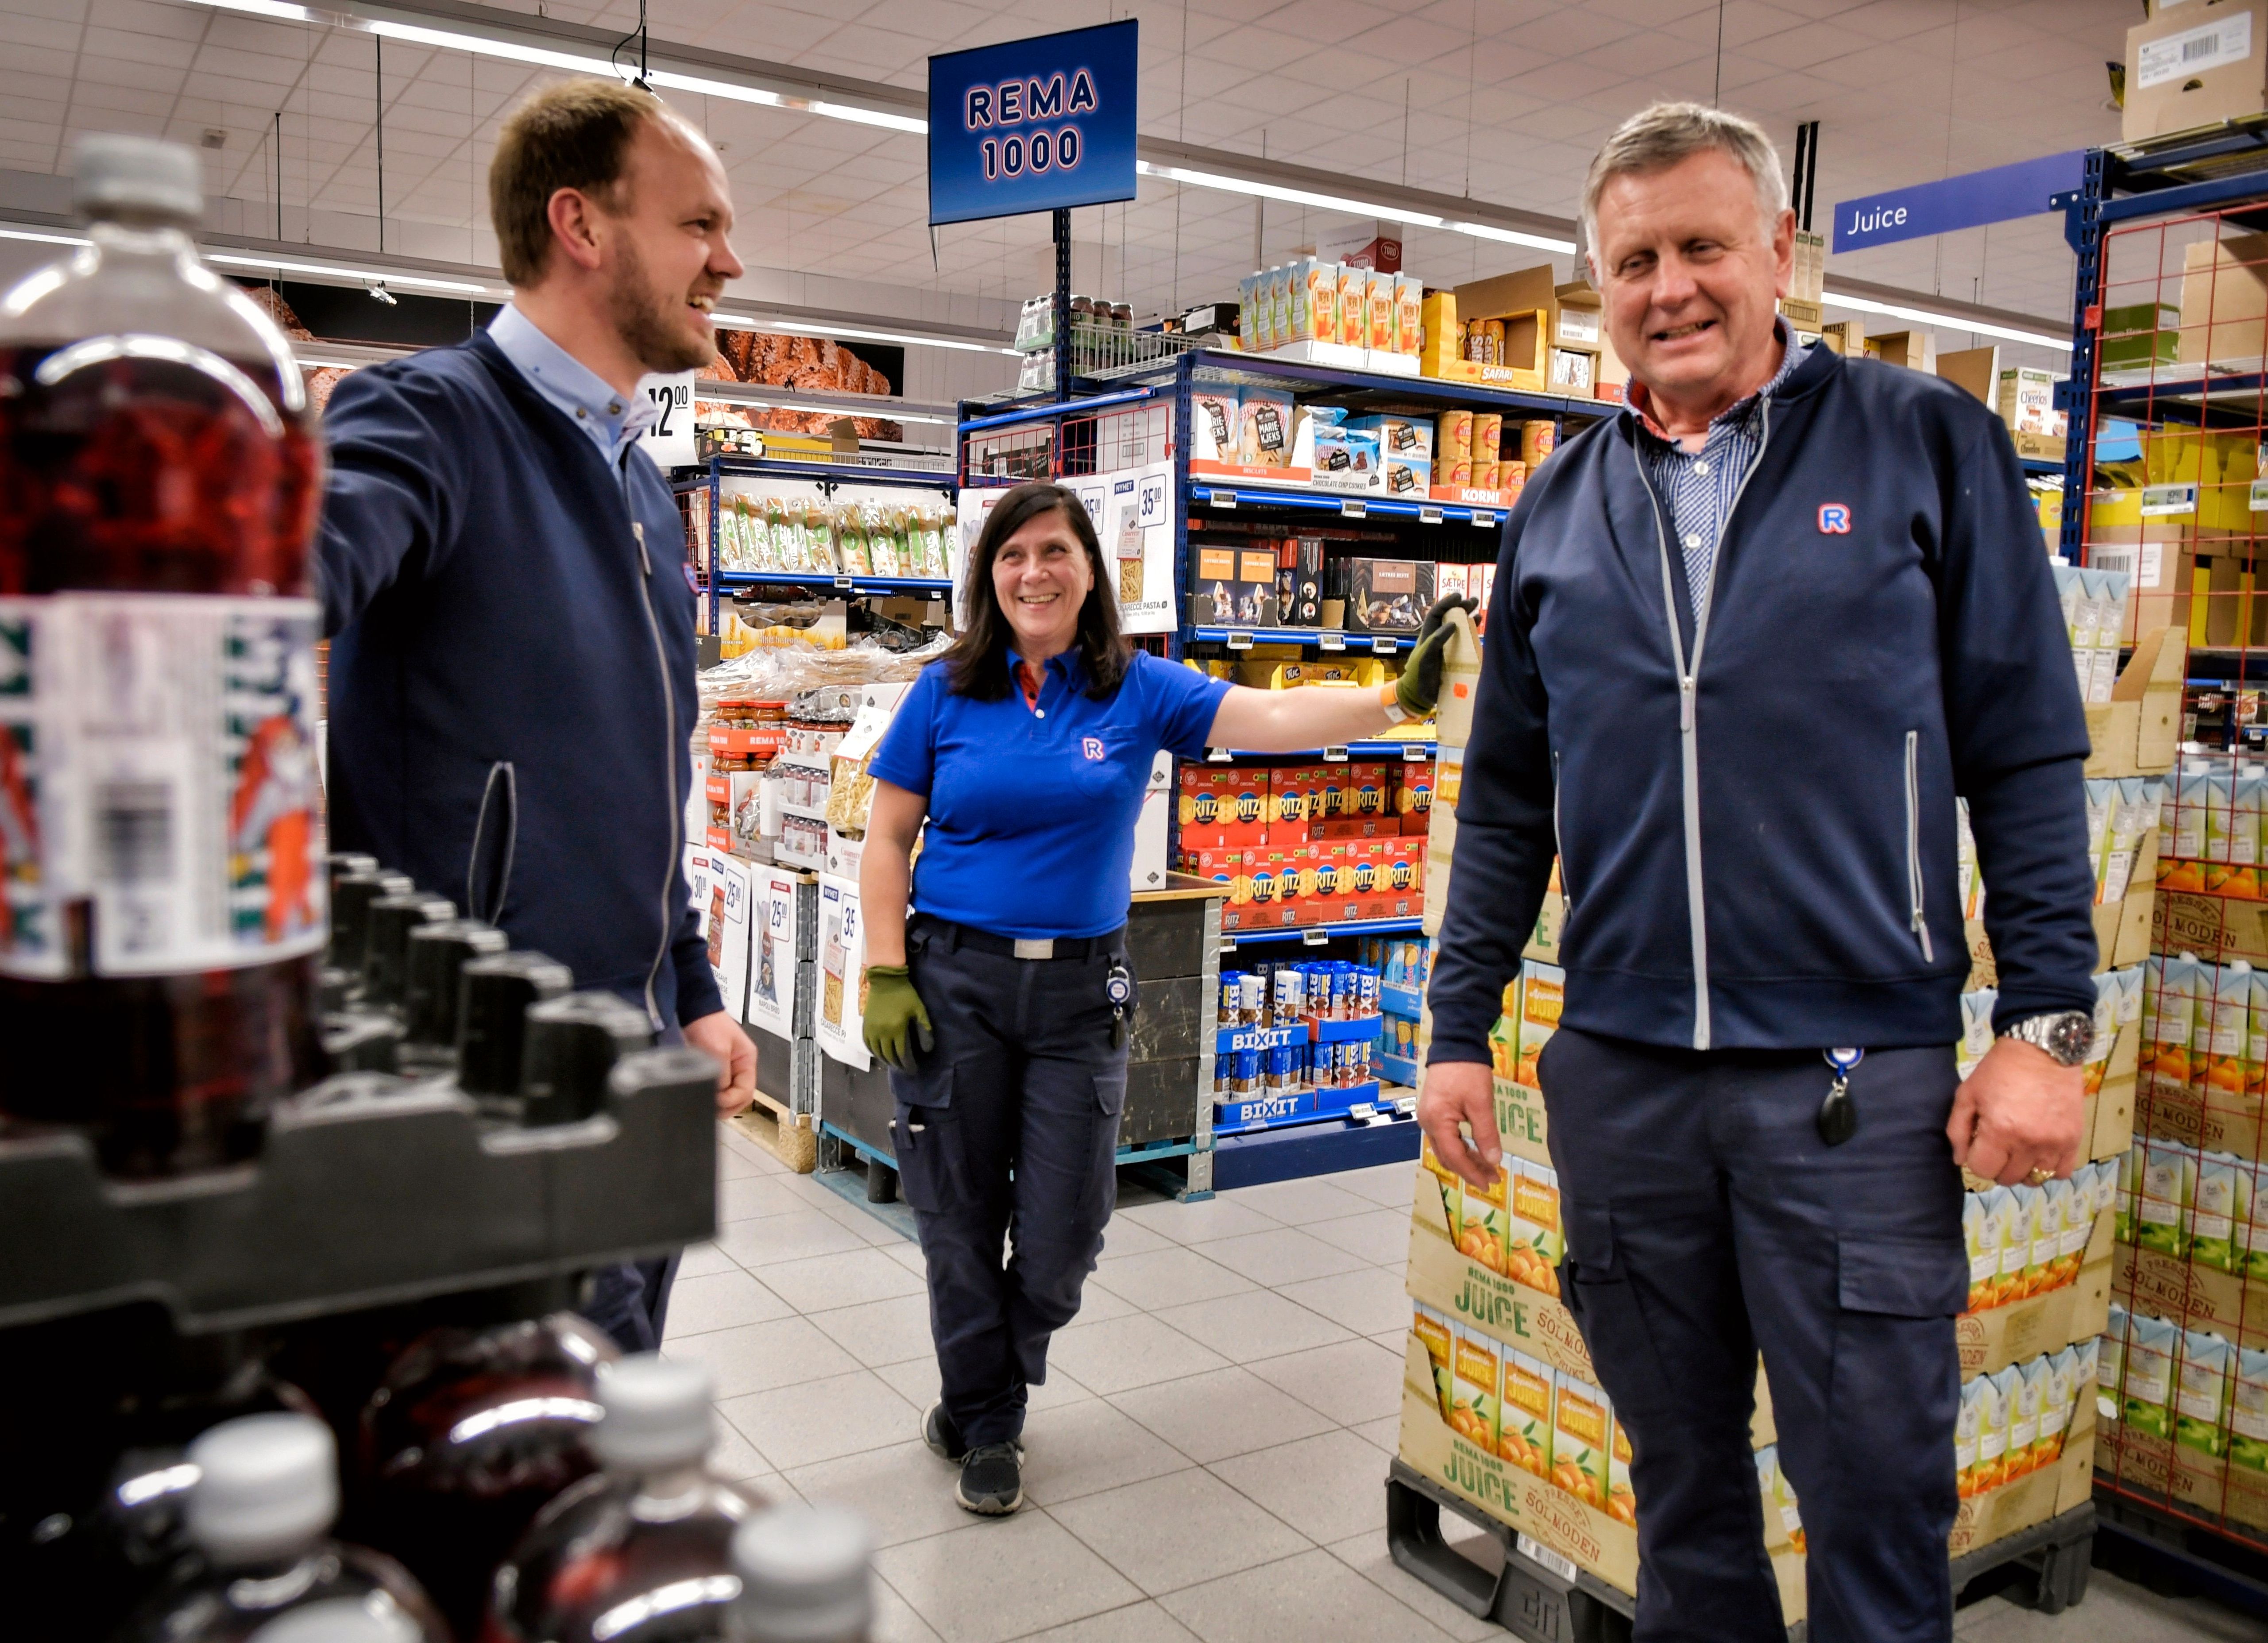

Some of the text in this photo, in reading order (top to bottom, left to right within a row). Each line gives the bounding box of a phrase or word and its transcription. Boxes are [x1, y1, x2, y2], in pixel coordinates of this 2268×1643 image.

[967, 69, 1096, 129] REMA
[983, 127, 1080, 180] 1000
[1847, 205, 1908, 236] Juice
[1384, 245, 1396, 257] TORO
[1481, 367, 1513, 382] SAFARI
[2020, 390, 2047, 406] Cheerios
[649, 386, 688, 436] 12 00
[1258, 420, 1280, 434] MARIE-
[1260, 431, 1281, 445] KJEKS
[1116, 482, 1132, 492] NYHET
[1313, 479, 1337, 488] CHOCOLATE
[1095, 498, 1101, 509] 00
[1142, 486, 1161, 516] 35 00
[1461, 488, 1499, 504] KORNI
[1818, 504, 1851, 533] R
[1442, 578, 1465, 589] SÆTRE
[1143, 601, 1161, 610] PASTA
[1286, 667, 1300, 680] TUC
[1326, 670, 1341, 680] TUC
[1082, 737, 1104, 760] R
[1235, 798, 1261, 817] RITZ
[1279, 798, 1302, 816] RITZ
[1358, 791, 1380, 807] RITZ
[1412, 791, 1432, 807] RITZ
[1192, 799, 1218, 818] RITZ
[1312, 825, 1325, 836] RITZ
[1363, 823, 1375, 834] RITZ
[1315, 871, 1338, 890] RITZ
[1353, 869, 1375, 887] RITZ
[1390, 867, 1412, 885] RITZ
[695, 875, 703, 899] 30
[726, 880, 741, 908] 25 00
[825, 887, 838, 900] NYHET
[1251, 879, 1275, 897] RITZ
[772, 899, 787, 928] 25 00
[1282, 910, 1296, 921] RITZ
[1344, 905, 1358, 916] RITZ
[1395, 902, 1408, 913] RITZ
[844, 907, 855, 938] 35
[1225, 914, 1240, 926] RITZ
[820, 1018, 841, 1034] CASARECCE
[1232, 1030, 1292, 1050] BIXIT
[1506, 1088, 1527, 1101] 1000
[1240, 1097, 1298, 1120] BIXIT
[1494, 1099, 1543, 1144] ICE
[1518, 1197, 1553, 1220] JUICE
[1468, 1267, 1515, 1296] REMA 1000
[2122, 1264, 2216, 1319] SOLMODEN
[1455, 1280, 1530, 1338] JUICE
[1459, 1361, 1491, 1383] JUICE
[1508, 1385, 1543, 1410] JUICE
[1561, 1412, 1598, 1438] JUICE
[1453, 1439, 1503, 1473] REMA 1000
[1444, 1451, 1519, 1516] JUICE
[1526, 1492, 1601, 1563] SOLMODEN
